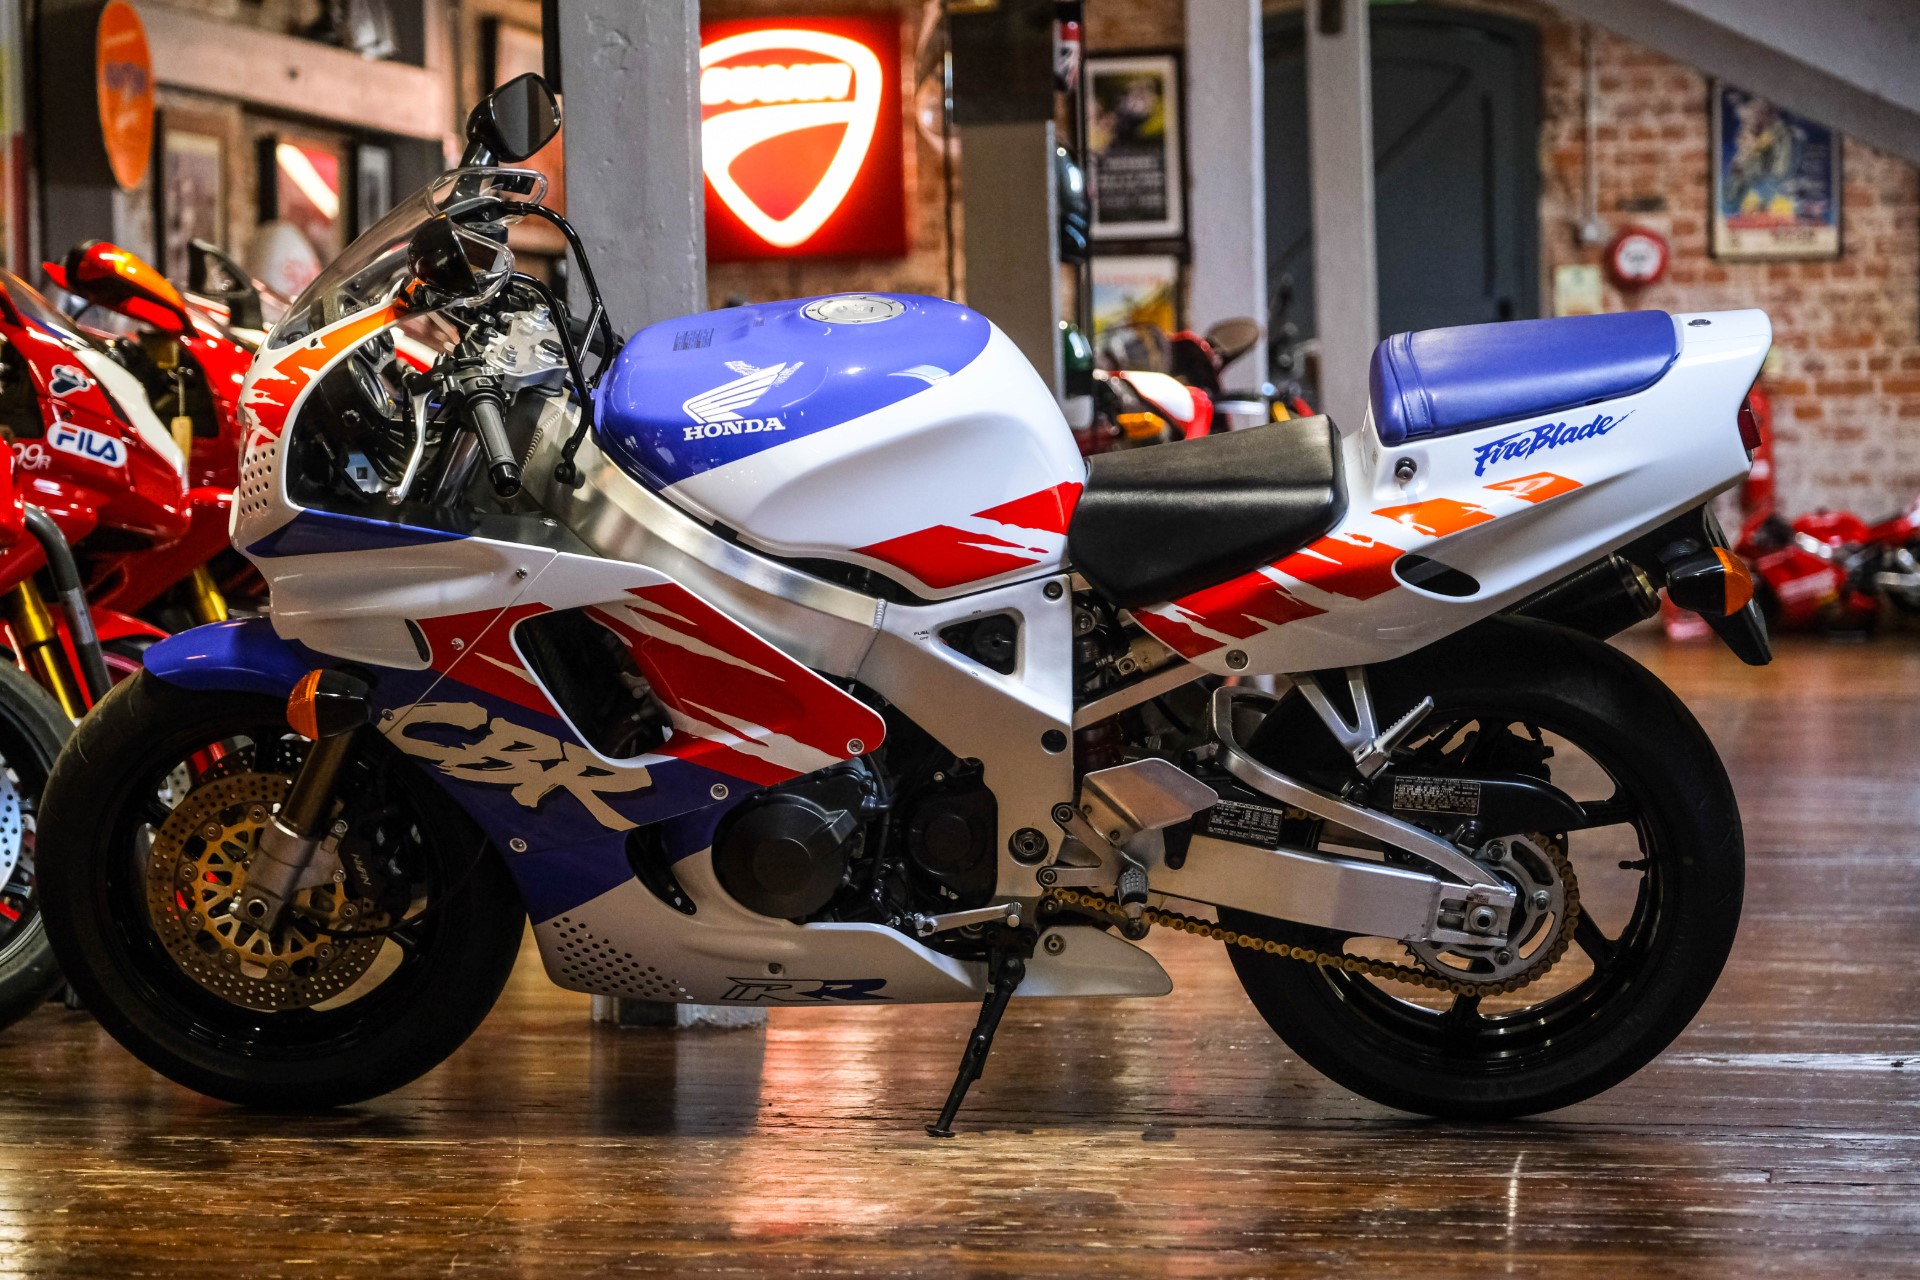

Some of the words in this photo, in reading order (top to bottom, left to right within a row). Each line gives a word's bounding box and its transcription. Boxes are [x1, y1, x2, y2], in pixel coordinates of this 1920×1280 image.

[56, 425, 118, 462] FILA
[682, 416, 786, 441] HONDA
[1473, 409, 1636, 477] FireBlade
[376, 701, 653, 832] CBR
[720, 976, 896, 1002] RR
